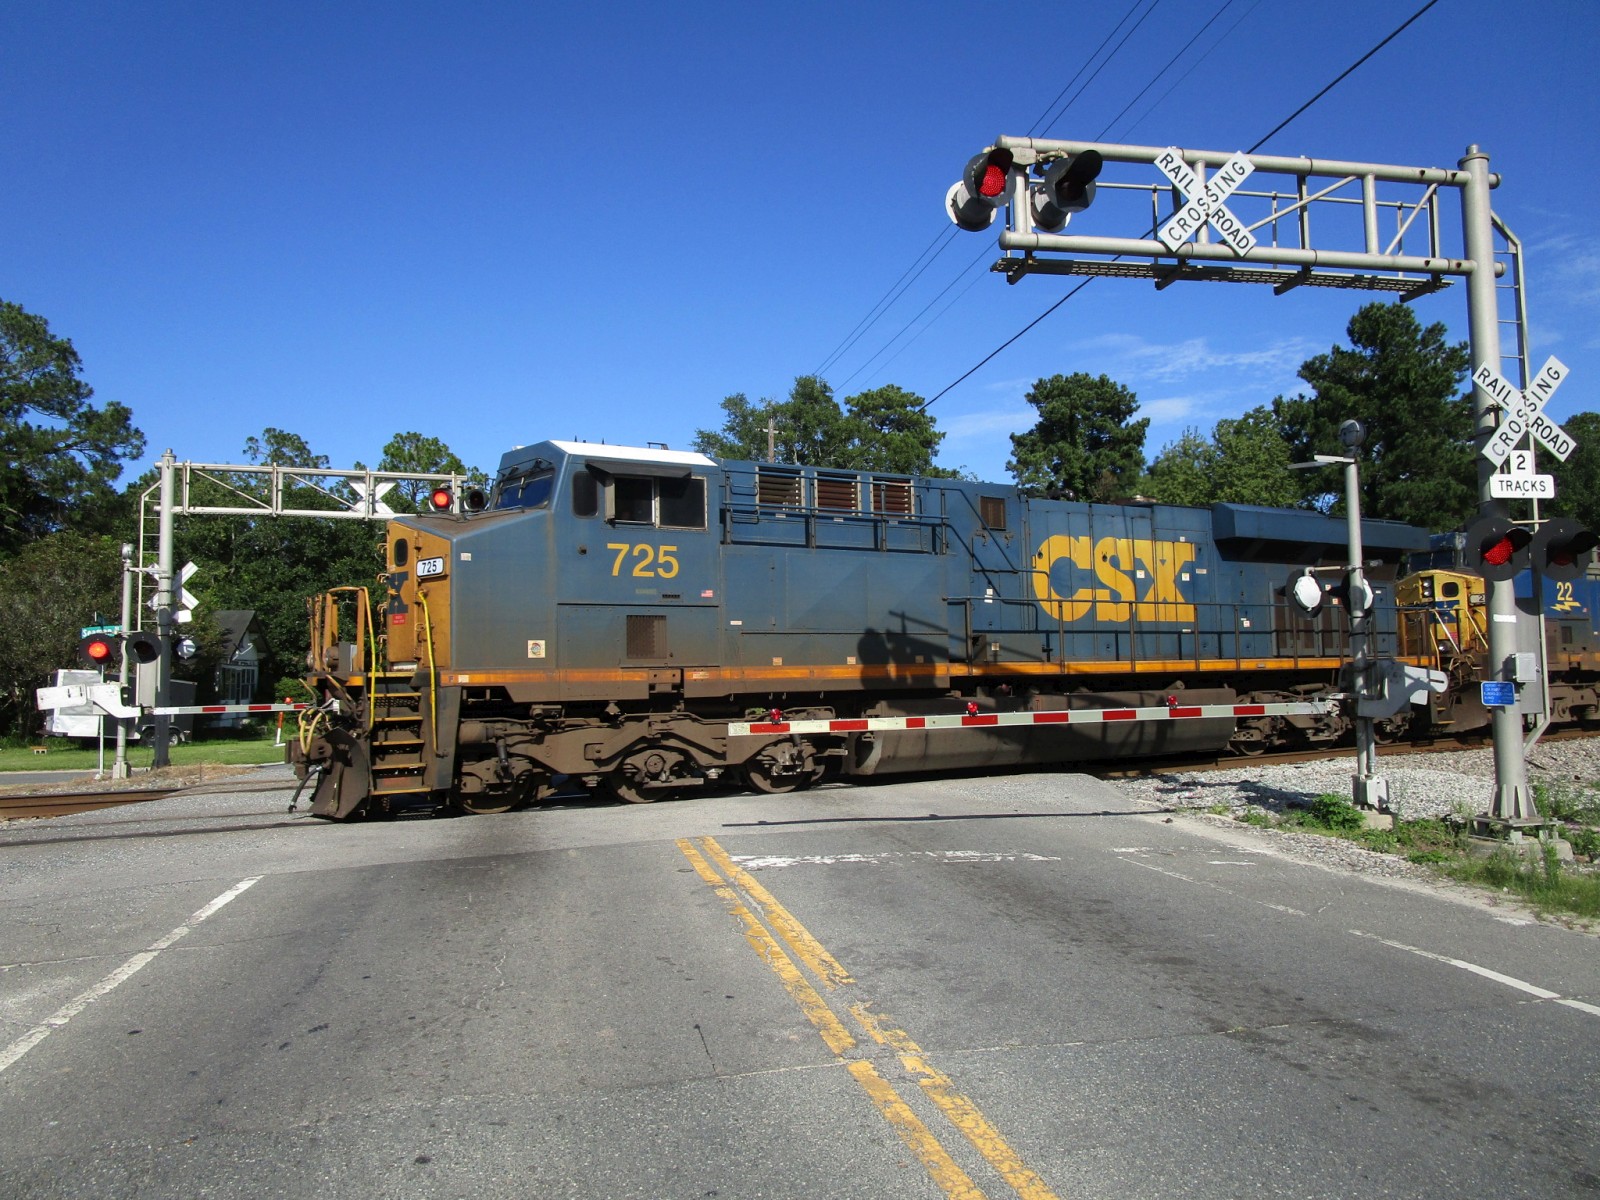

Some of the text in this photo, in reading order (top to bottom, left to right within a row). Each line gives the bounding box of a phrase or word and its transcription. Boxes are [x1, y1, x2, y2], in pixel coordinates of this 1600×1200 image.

[1159, 153, 1250, 249] RAIL ROAD
[1168, 161, 1246, 241] CROSSING
[1477, 367, 1570, 455] RAIL ROAD
[1492, 366, 1560, 457] CROSSING
[1498, 480, 1546, 492] TRACKS
[1516, 454, 1526, 470] 2
[421, 560, 437, 574] 725
[607, 543, 679, 579] 725
[1032, 535, 1195, 622] CSX
[1556, 581, 1573, 601] 22
